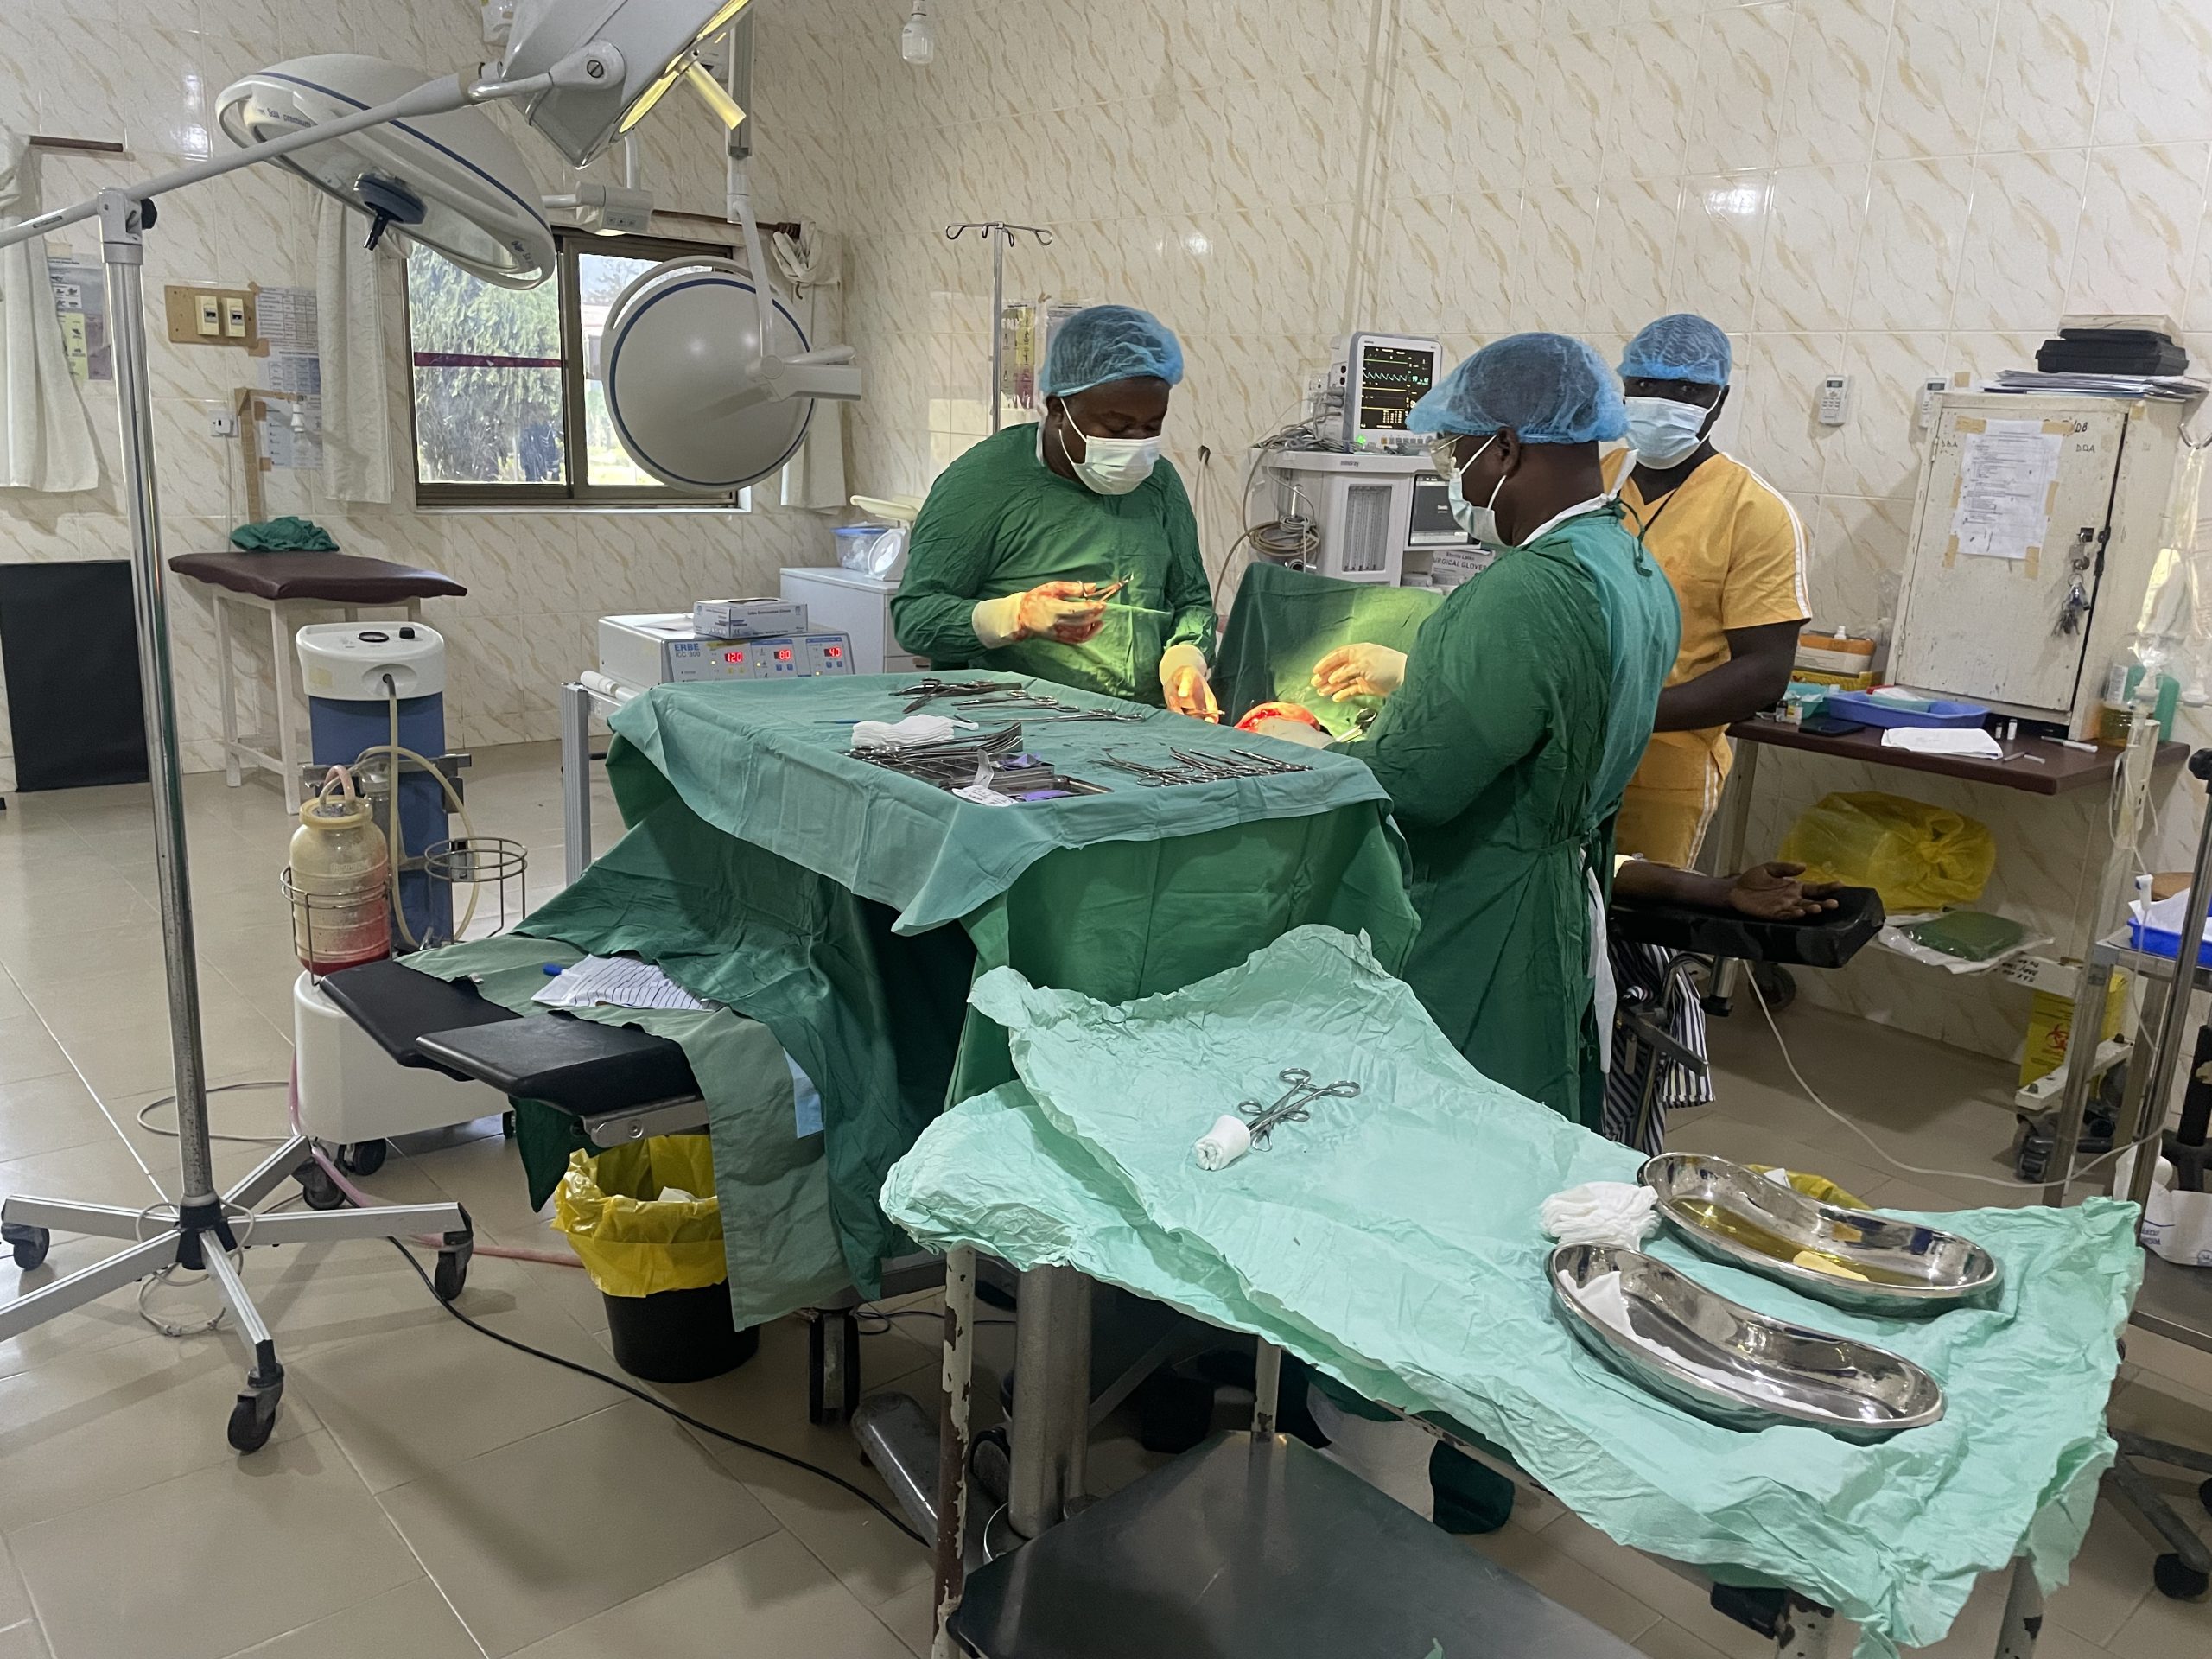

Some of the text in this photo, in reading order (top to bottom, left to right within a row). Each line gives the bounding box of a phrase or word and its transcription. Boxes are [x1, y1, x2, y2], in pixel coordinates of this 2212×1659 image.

[674, 643, 700, 652] ERBE
[829, 647, 841, 657] 40
[727, 652, 743, 663] 120
[779, 650, 791, 660] 80
